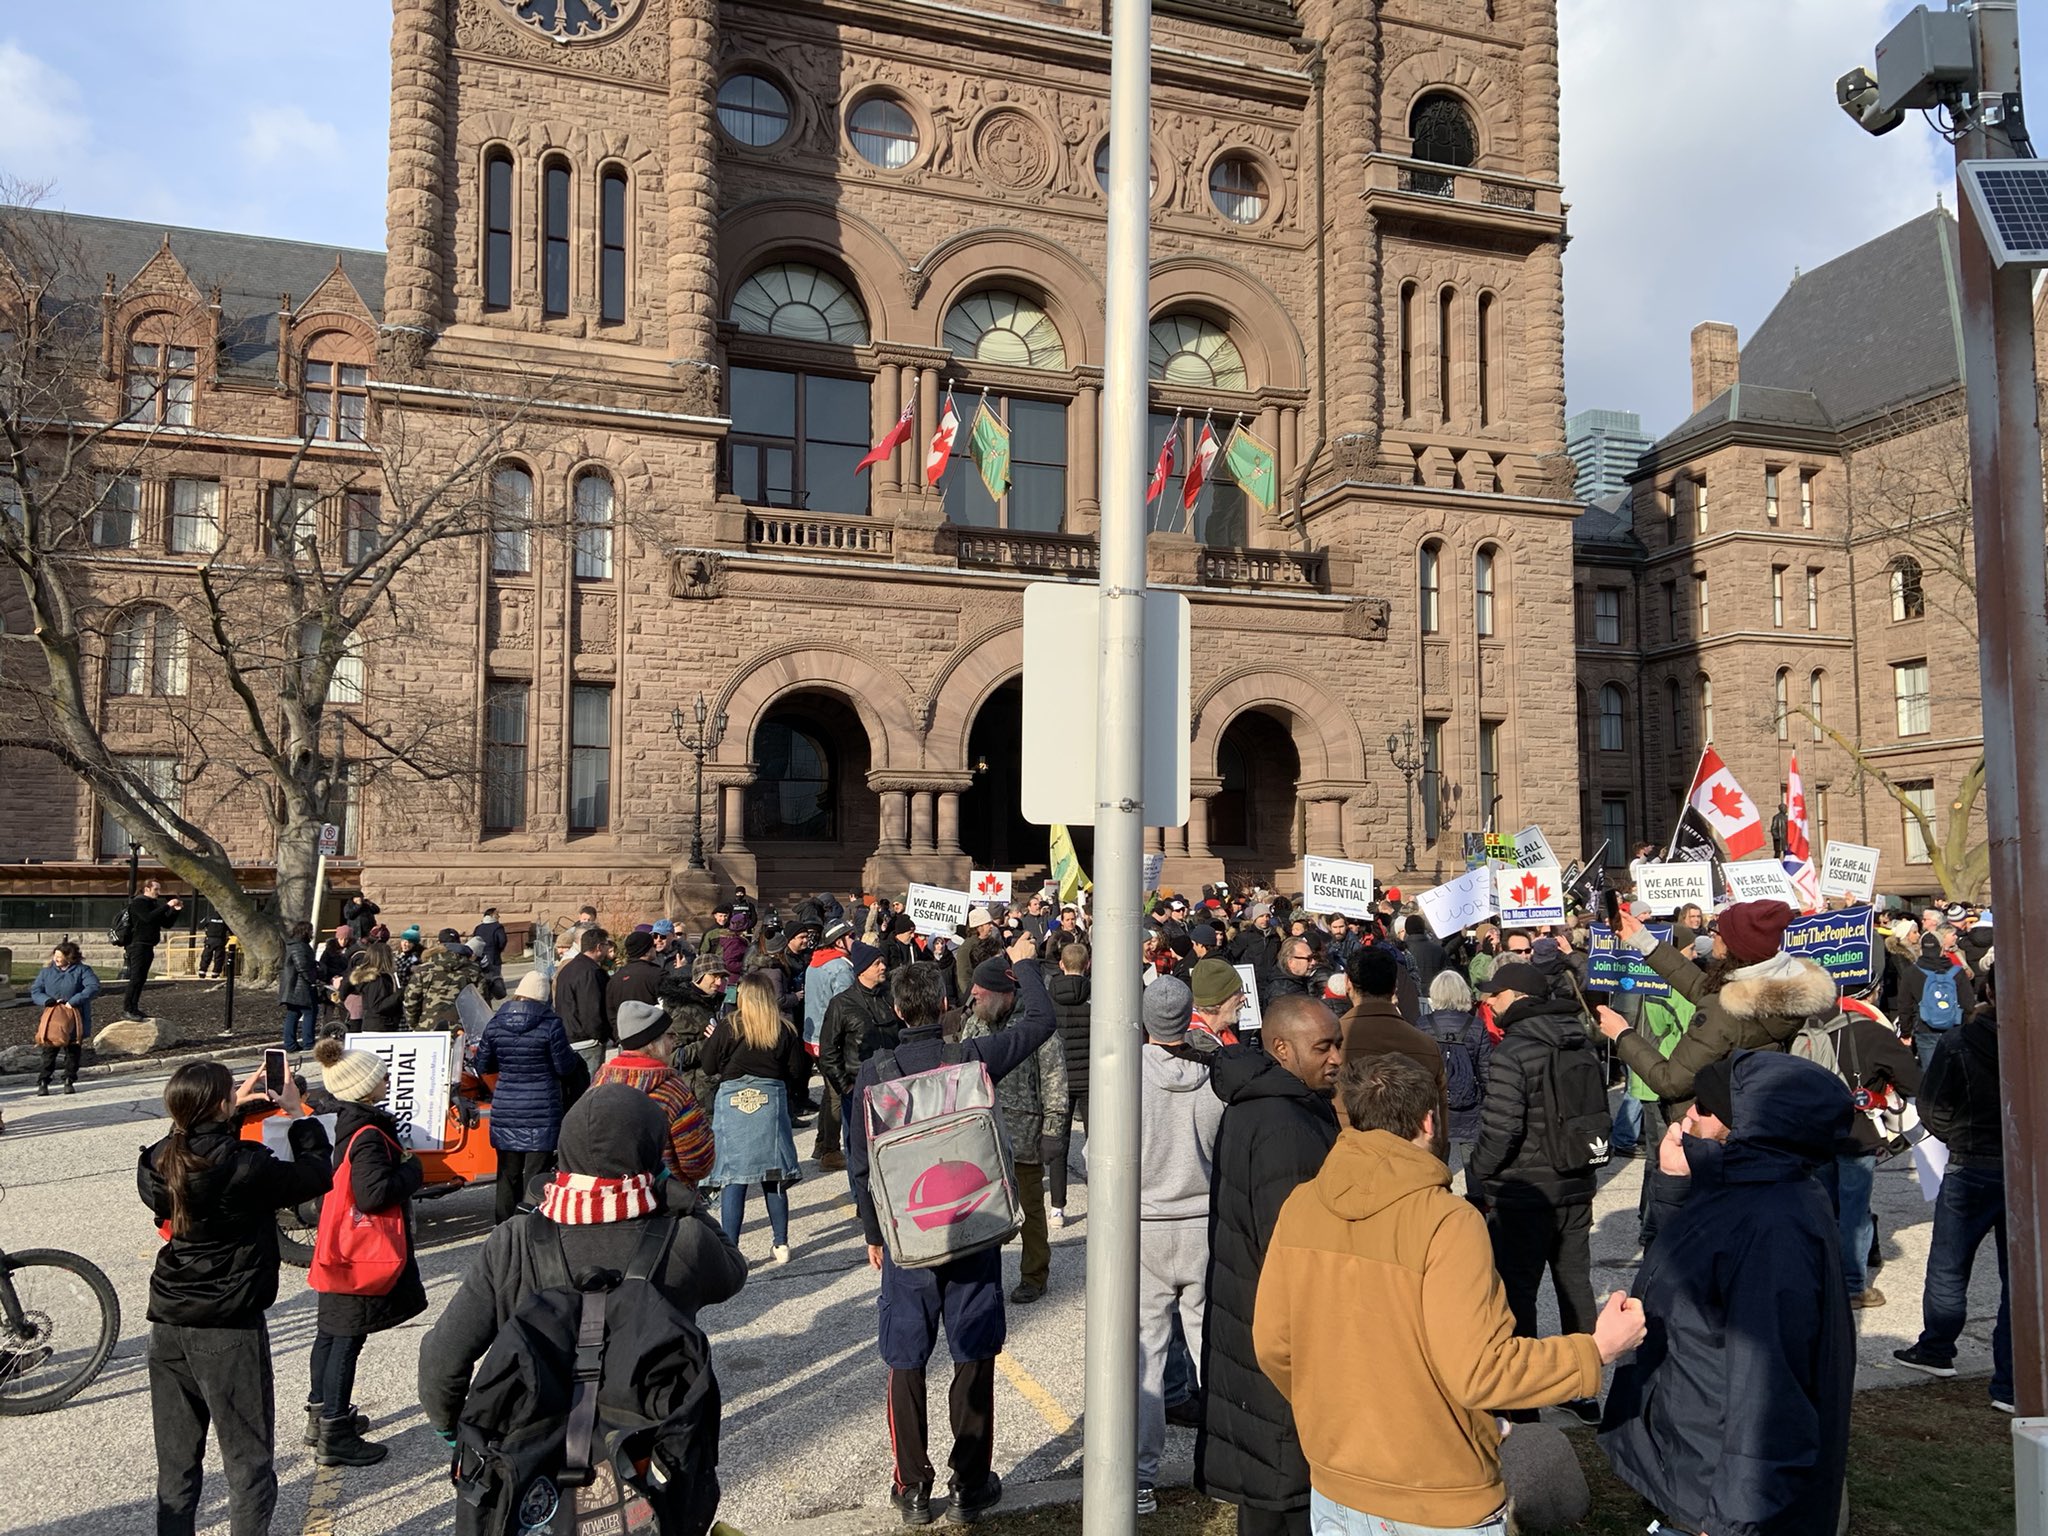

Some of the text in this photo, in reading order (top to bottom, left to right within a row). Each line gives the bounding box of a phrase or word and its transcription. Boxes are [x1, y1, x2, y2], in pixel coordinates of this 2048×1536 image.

[1523, 840, 1543, 855] ALL
[1516, 851, 1546, 869] NTIAL
[1829, 856, 1871, 873] WE ARE ALL
[1311, 871, 1367, 890] WE ARE ALL
[1644, 876, 1705, 888] WE ARE ALL
[1733, 875, 1750, 886] WE
[1750, 874, 1767, 885] ARE
[1767, 873, 1783, 883] ALL
[1828, 868, 1867, 884] ESSENTIAL
[1314, 884, 1366, 902] ESSENTIAL
[1648, 888, 1703, 900] ESSENTIAL
[1741, 884, 1787, 897] ESSENTIAL
[913, 897, 929, 908] WE
[929, 900, 947, 912] ARE
[946, 903, 963, 915] ALL
[1436, 893, 1489, 923] WOR
[913, 908, 959, 924] ESSENTIAL
[1787, 921, 1865, 950] UnifyThePeople.ca
[1823, 950, 1863, 966] Solution
[1593, 960, 1656, 975] Join the Solut
[1840, 970, 1849, 978] the
[1849, 968, 1868, 978] People
[581, 1513, 620, 1536] ATWATER
